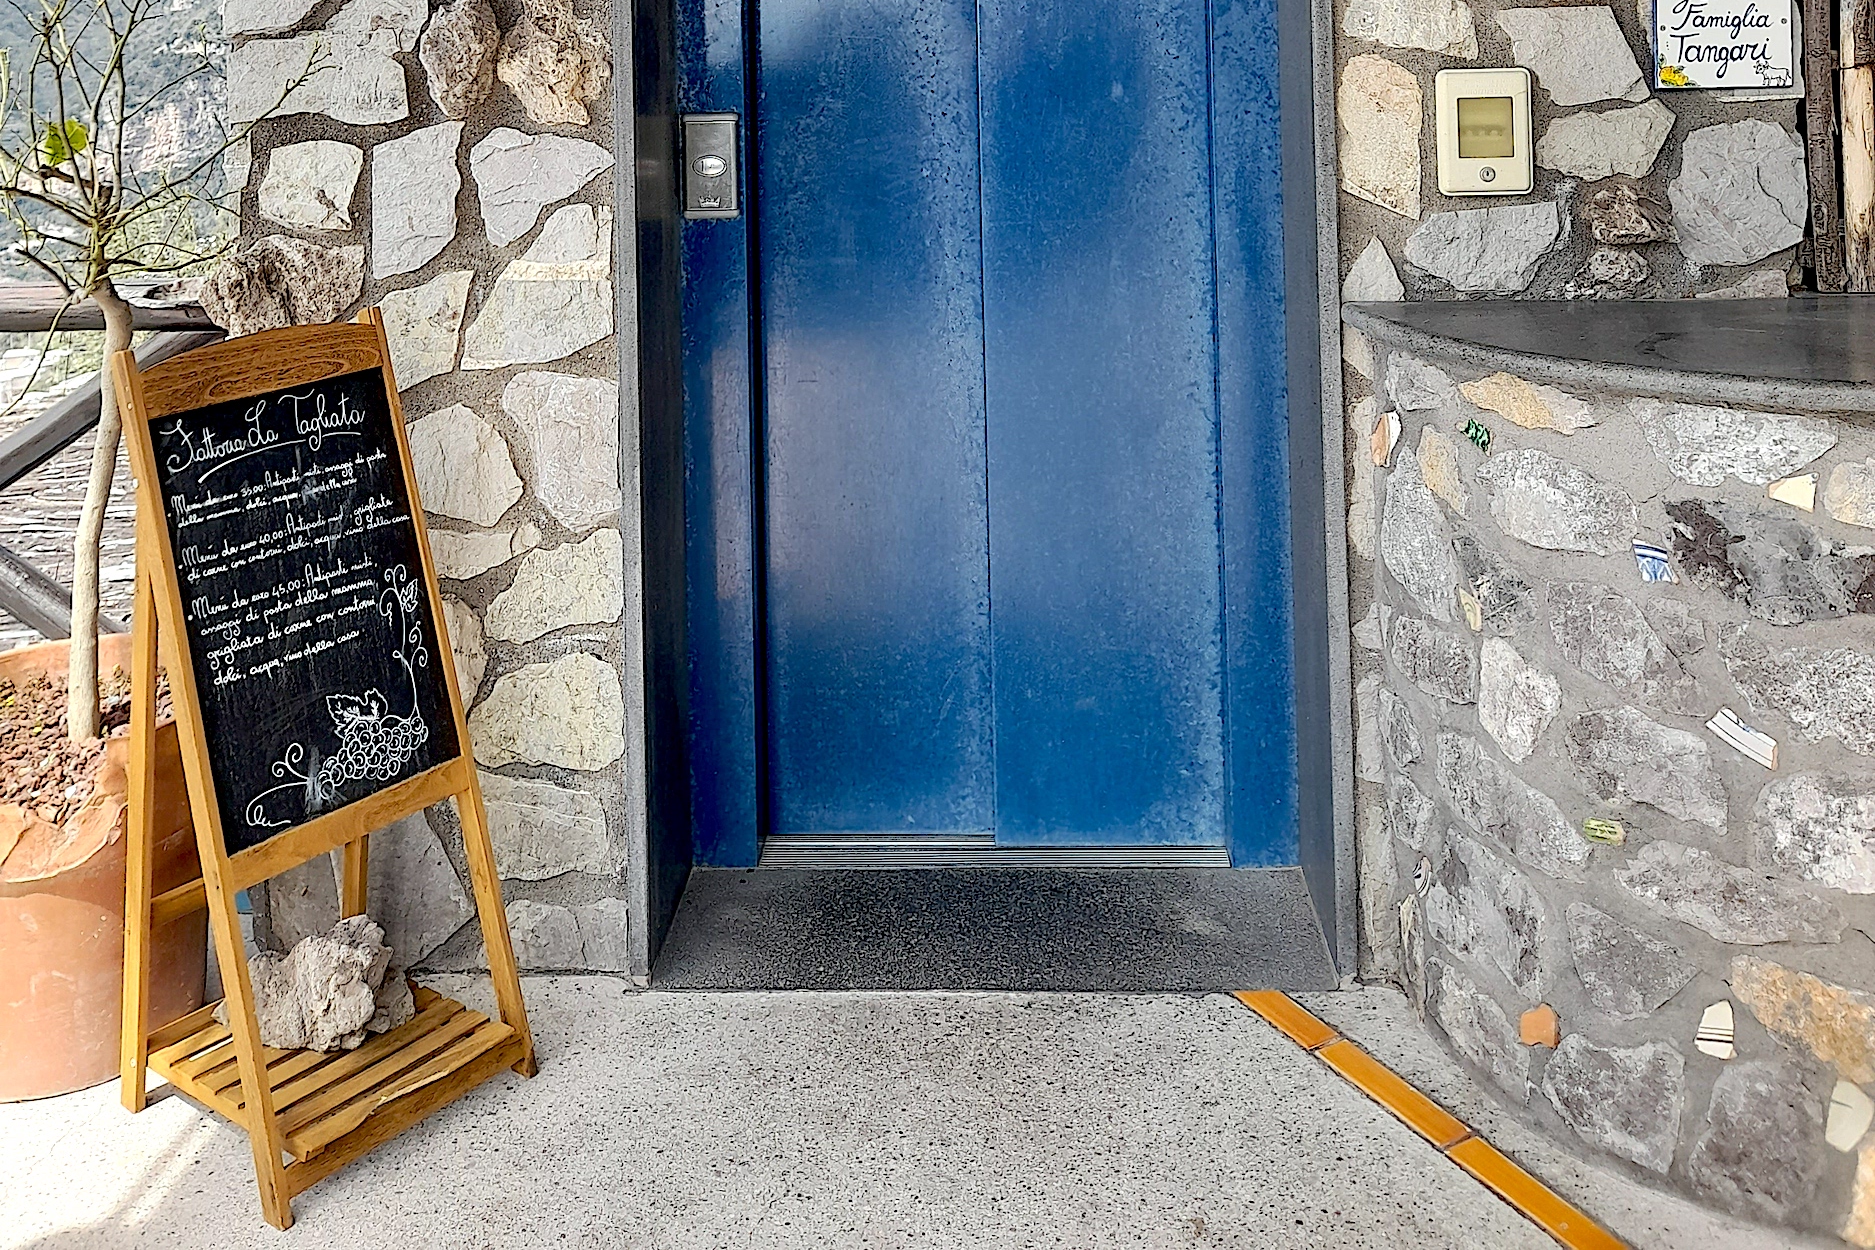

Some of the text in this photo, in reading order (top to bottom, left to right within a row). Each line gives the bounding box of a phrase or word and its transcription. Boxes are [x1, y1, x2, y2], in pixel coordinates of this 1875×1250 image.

[1671, 2, 1774, 40] Famiglia
[1670, 33, 1773, 79] Tangari
[159, 388, 365, 473] Fattoria La Tagliata
[355, 452, 364, 464] di
[178, 514, 204, 528] della
[321, 477, 341, 492] della
[221, 538, 239, 556] da
[354, 493, 393, 526] grigliata
[187, 567, 201, 581] di
[203, 564, 229, 577] carne
[231, 559, 247, 569] con
[344, 526, 364, 536] vino
[366, 515, 391, 530] della
[392, 514, 410, 524] casa
[200, 614, 241, 641] assaggi
[245, 606, 260, 622] di
[263, 599, 293, 624] pasta
[295, 588, 328, 607] della
[231, 589, 249, 608] da
[207, 636, 264, 671] grigliata
[267, 622, 281, 640] di
[283, 619, 313, 634] carne
[316, 611, 335, 623] con
[283, 650, 303, 662] vino
[303, 640, 335, 656] della
